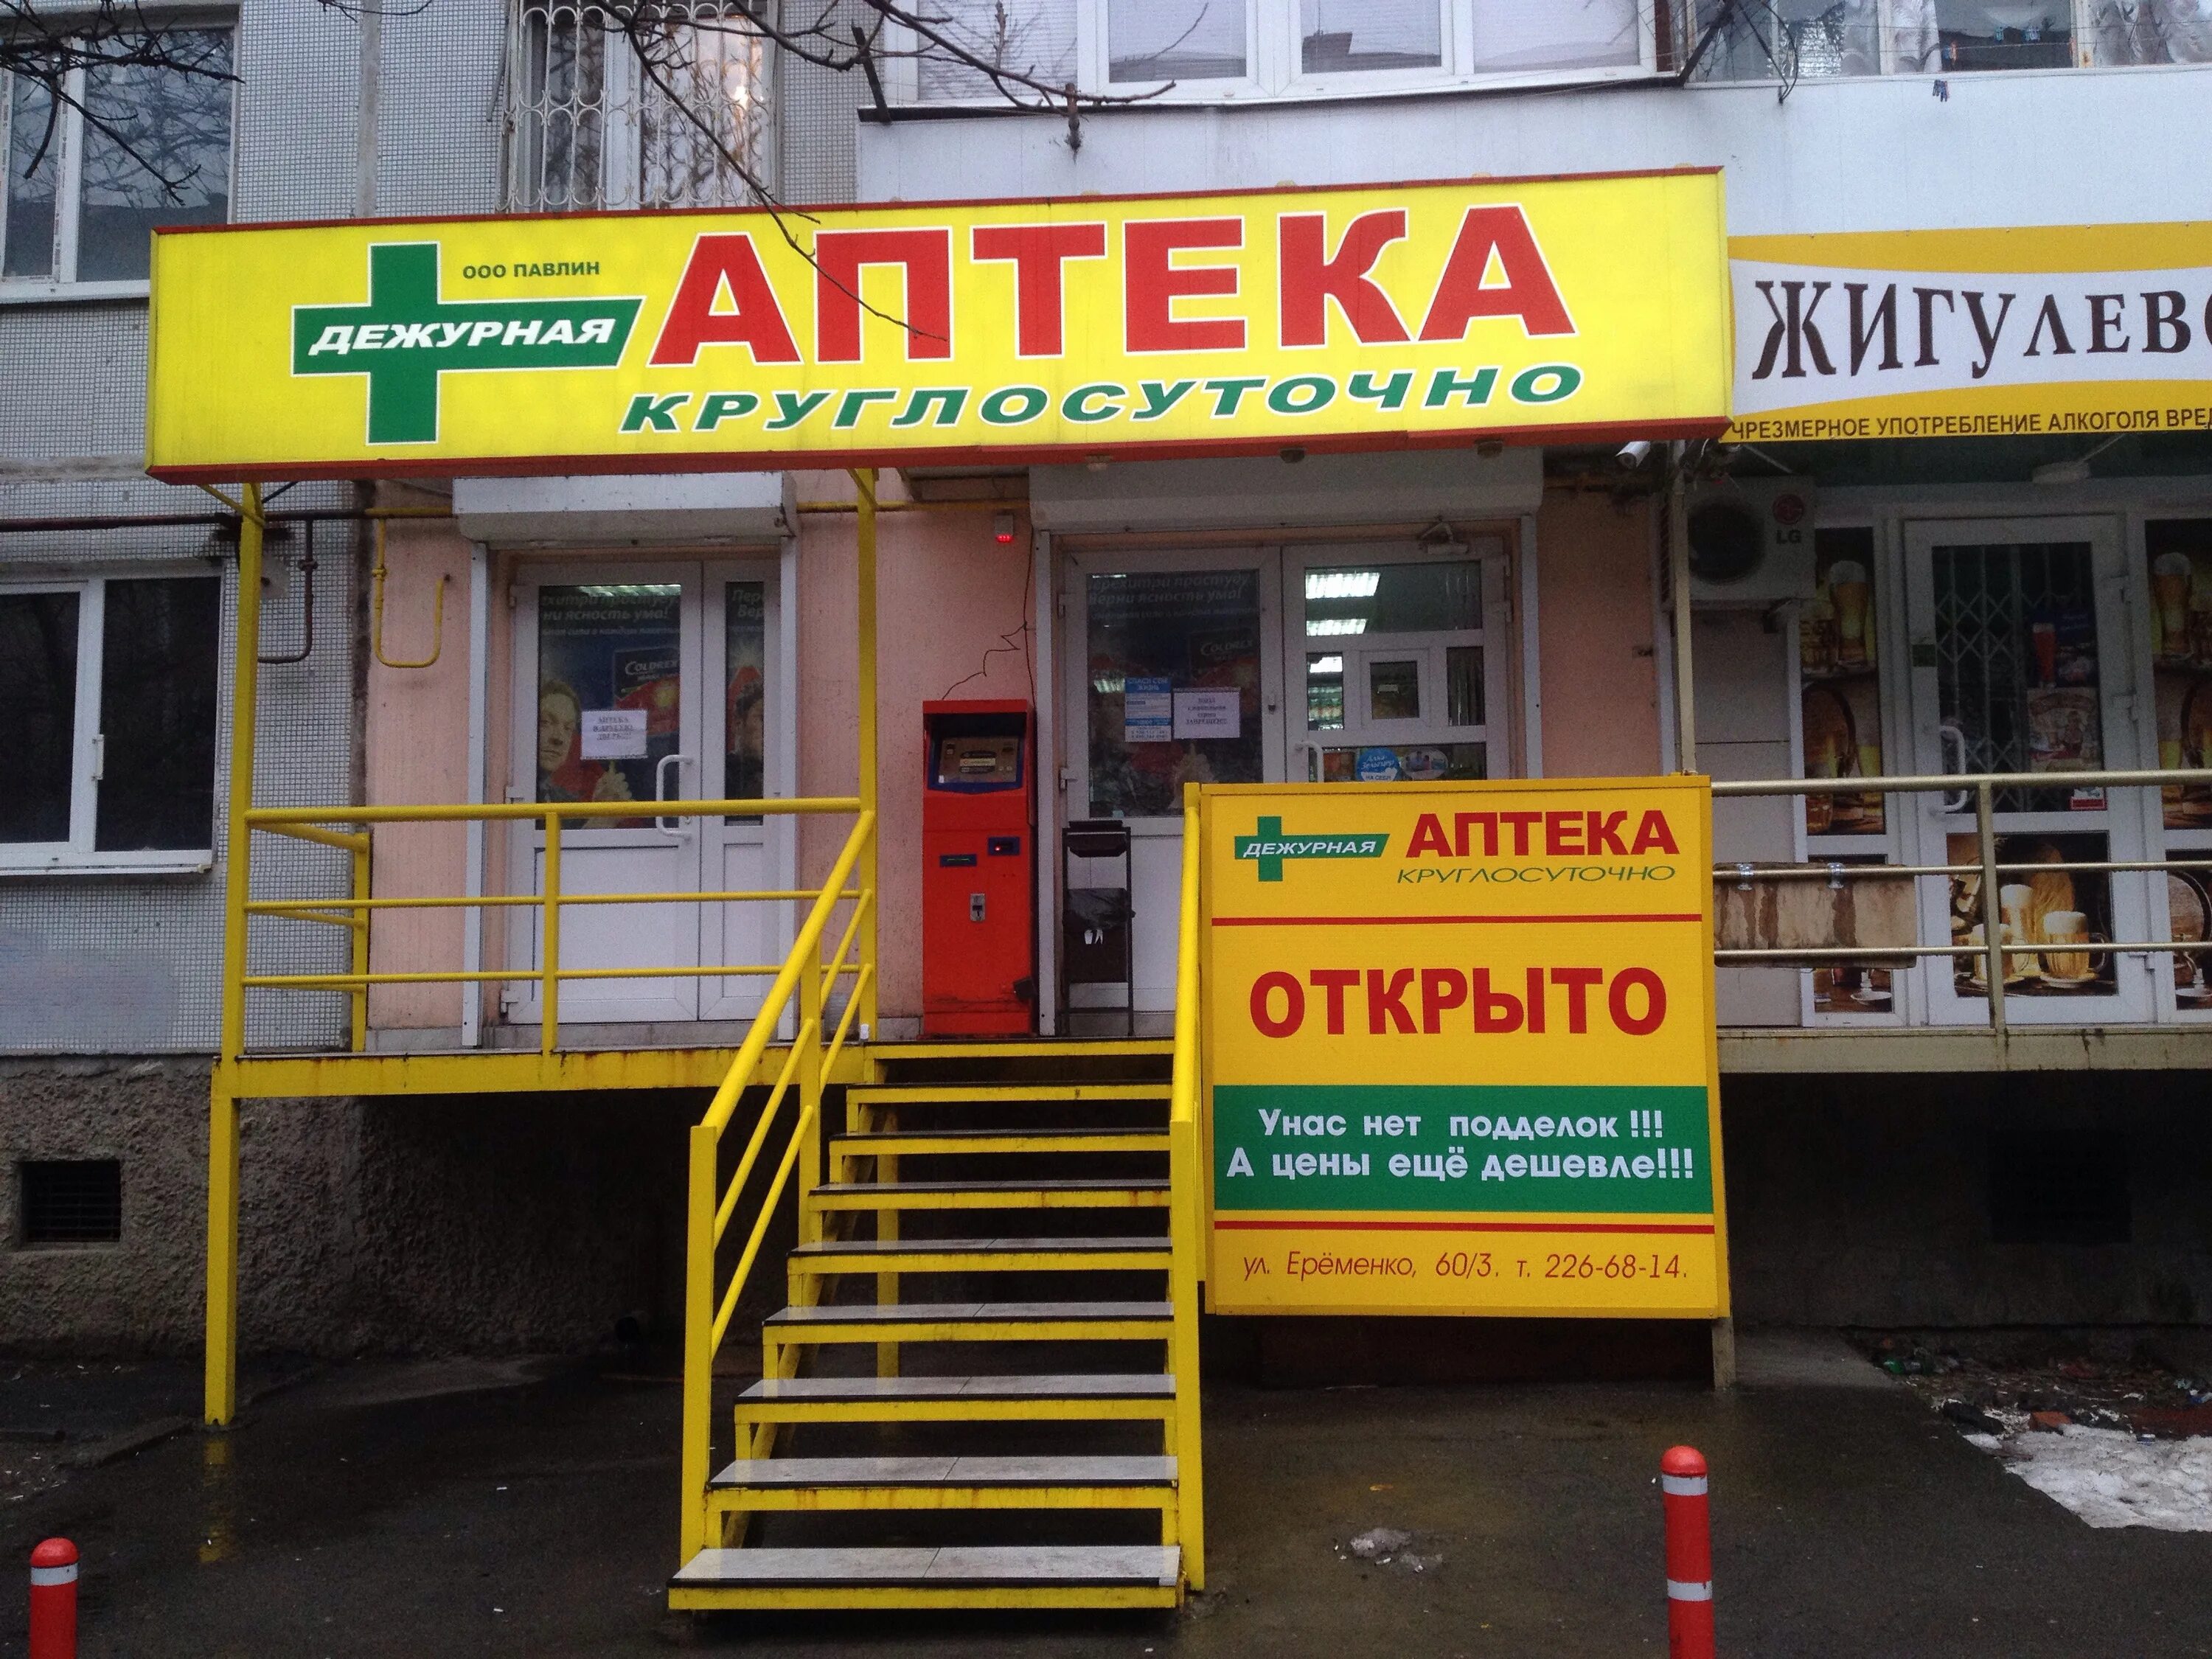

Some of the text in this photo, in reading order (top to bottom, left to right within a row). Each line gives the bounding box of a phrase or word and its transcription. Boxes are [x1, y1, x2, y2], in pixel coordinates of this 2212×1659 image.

[462, 261, 600, 279] ООО ПАВЛИН
[646, 202, 1579, 368] АПТЕКА
[308, 318, 616, 357] ДЕЖУРНАЯ
[1752, 279, 2212, 380] ЖИГУЛЕВ
[618, 362, 1583, 434] КРУГЛОСУТОЧНО
[1733, 418, 1870, 439] ЧРЕЗМЕРНОЕ
[1877, 414, 2042, 436] УПОТРЕБЛЕНИЕ
[2048, 409, 2158, 432] АЛКОГОЛЯ
[1775, 529, 1801, 544] LG
[1242, 839, 1377, 858] ДЕЖУРНАЯ
[1405, 810, 1680, 858] АПТЕКА
[1397, 865, 1677, 885] КРУГЛОСУТОЧНО
[1249, 967, 1667, 1039] ОТКРЫТО
[1258, 1108, 1347, 1138] Унас
[1363, 1115, 1422, 1136] нет
[1450, 1115, 1618, 1141] подделок
[1227, 1147, 1694, 1182] А цены ещё дешевле!!!
[1242, 1251, 1688, 1282] ул. Ерёменко, 60/3. т. 226-68-14.
